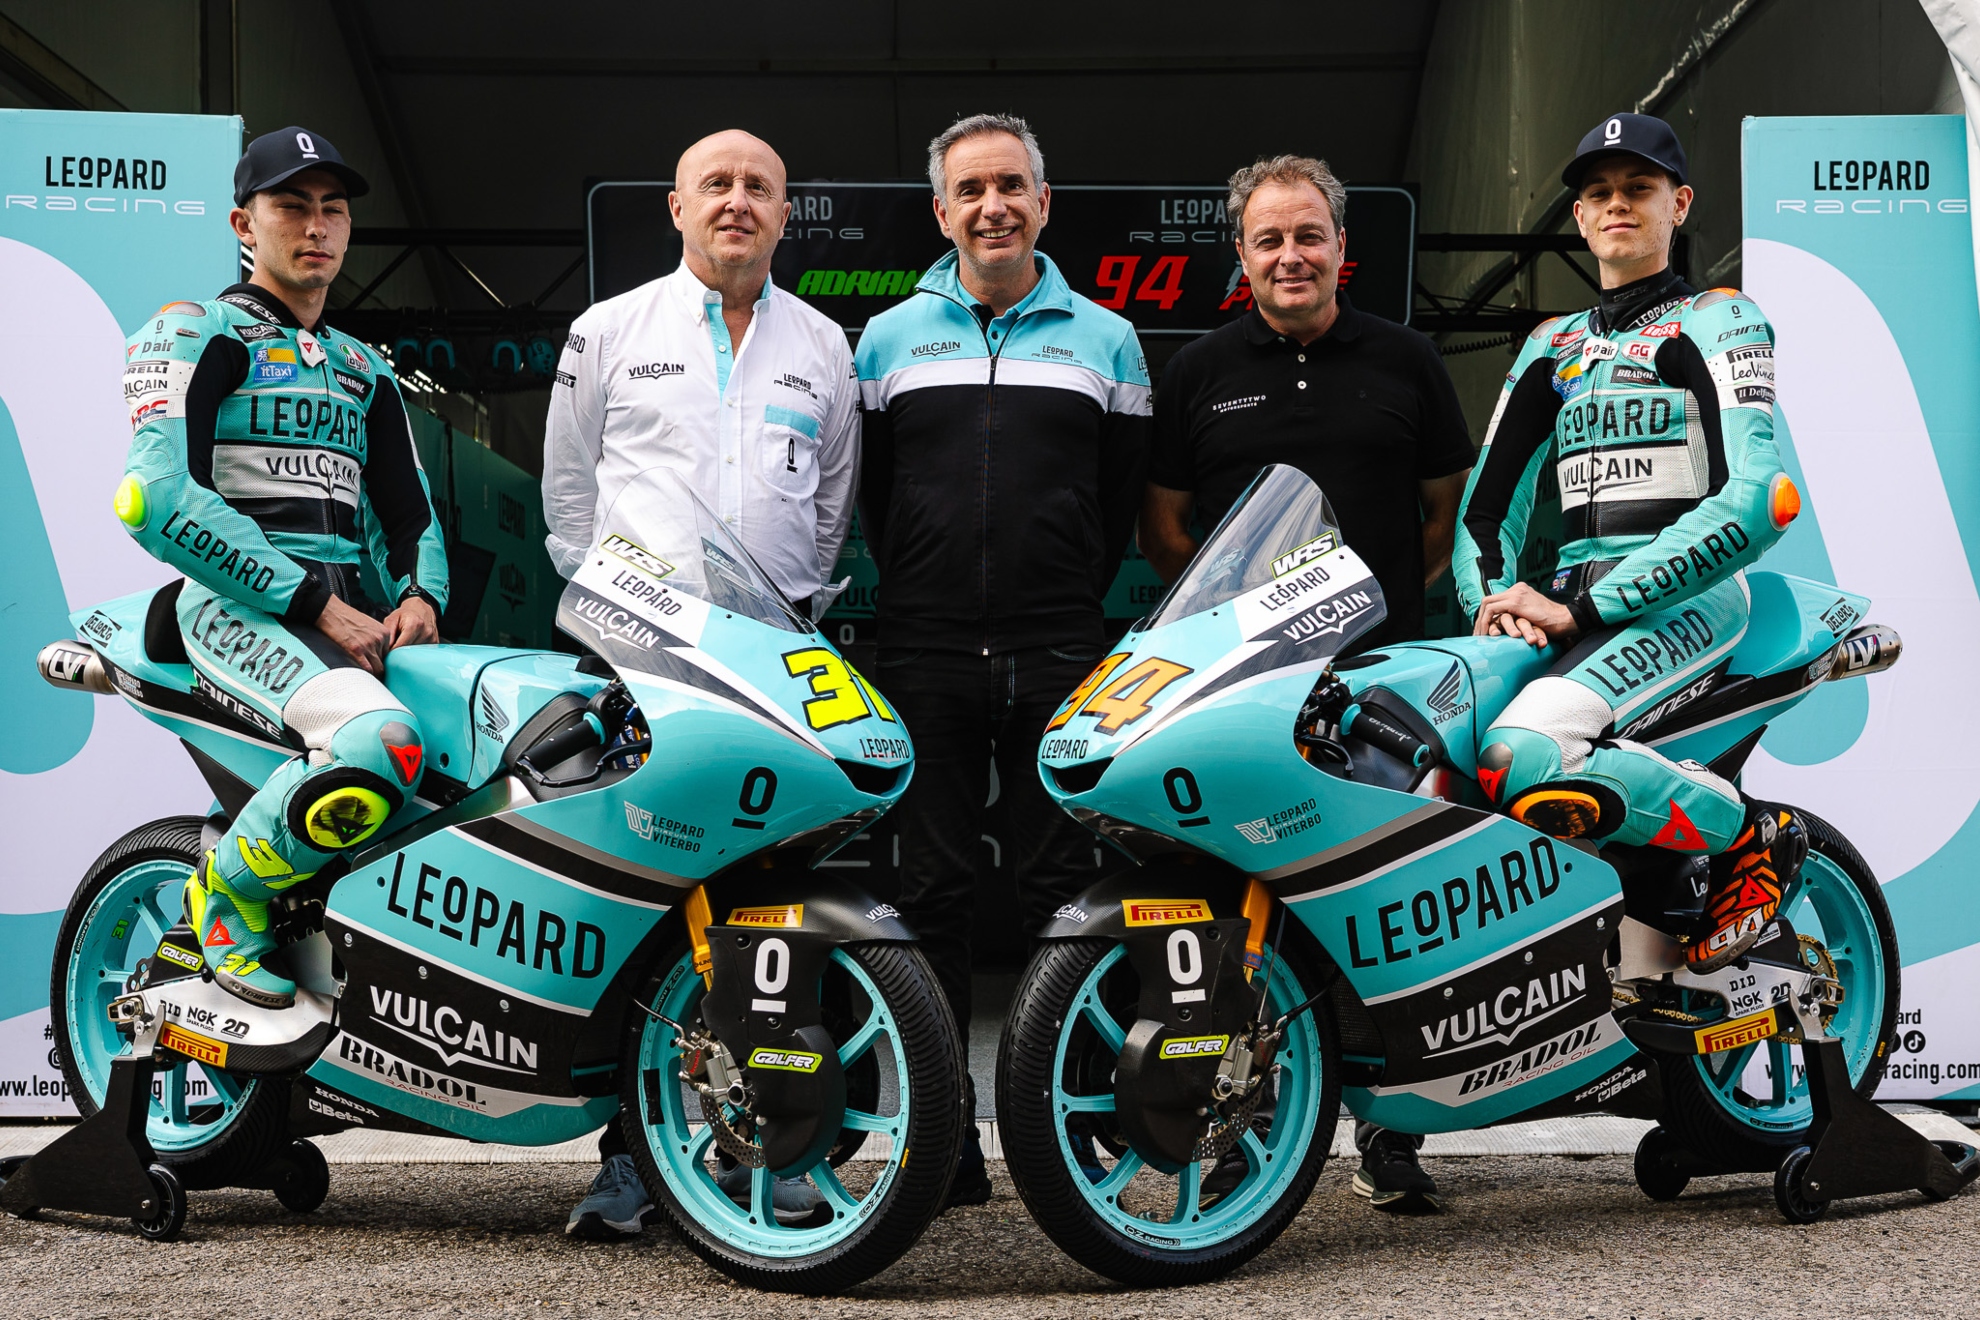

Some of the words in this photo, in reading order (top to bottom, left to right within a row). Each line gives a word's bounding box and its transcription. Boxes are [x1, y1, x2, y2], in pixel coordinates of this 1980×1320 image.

[46, 156, 166, 190] LEOPARD
[1814, 160, 1930, 192] LEOPARD
[1161, 199, 1235, 225] LEOPA
[1091, 255, 1190, 311] 94
[239, 324, 277, 337] VULCAIN
[1717, 324, 1767, 343] DAINE
[911, 341, 961, 356] VULCAIN
[1042, 345, 1074, 357] LEOPARD
[1629, 344, 1650, 357] GG
[1725, 344, 1774, 364] PIRELL
[336, 373, 366, 394] BRADOL
[628, 362, 685, 377] VULCAIN
[1616, 369, 1655, 380] BRADOL
[124, 380, 168, 396] ULCAIN
[1560, 397, 1671, 449] EOPARD
[265, 453, 357, 485] VULCAIN
[1563, 456, 1653, 488] VULCAIN
[161, 510, 276, 594] LEOPARD
[602, 535, 673, 576] WRS
[1272, 533, 1335, 578] WRS
[1616, 521, 1750, 614] LEOPARD
[611, 570, 682, 616] LEOPARD
[1259, 566, 1331, 613] LEOPARD
[574, 596, 660, 649] VULCAIN
[1282, 590, 1373, 642] VULCAIN
[192, 598, 305, 694] LEOPARD
[1586, 608, 1714, 698] LEOPARD
[1432, 701, 1472, 726] HONDA
[1618, 671, 1716, 740] DAINESE
[476, 720, 505, 745] HONDA
[859, 738, 911, 760] LEOPARD
[1041, 738, 1089, 760] LEOPARD
[652, 814, 705, 839] LEOPARD
[1266, 797, 1317, 827] LEOPARD
[1275, 812, 1322, 840] VITERBO
[653, 831, 701, 853] VITERBO
[387, 850, 607, 980] LEOPARD
[735, 909, 798, 925] PIRELLI
[1131, 902, 1204, 923] PIRELLI
[1345, 835, 1561, 969] LEOPARD
[161, 945, 199, 968] GALFER
[187, 1005, 218, 1027] NGK
[1421, 963, 1587, 1051] VULCAIN
[1731, 991, 1764, 1012] NGK
[1735, 1008, 1750, 1016] SPARK
[186, 1018, 200, 1027] SPARK
[222, 1018, 250, 1036] 2D
[370, 984, 538, 1069] VULCAIN
[1703, 1016, 1772, 1054] PIRELLI
[163, 1027, 221, 1065] PIRELLI
[752, 1051, 819, 1069] GALFER
[1164, 1038, 1226, 1056] GALFER
[1458, 1021, 1602, 1097] BRADOL
[338, 1030, 487, 1106] BRADOL
[1502, 1058, 1564, 1088] RACING
[1570, 1047, 1597, 1061] OIL
[385, 1078, 450, 1103] RACING
[457, 1100, 488, 1114] OIL
[1574, 1066, 1634, 1103] HONDA
[1610, 1068, 1648, 1098] Beta
[315, 1085, 380, 1118] HONDA
[322, 1102, 365, 1125] Beta
[1145, 1235, 1174, 1246] RACING
